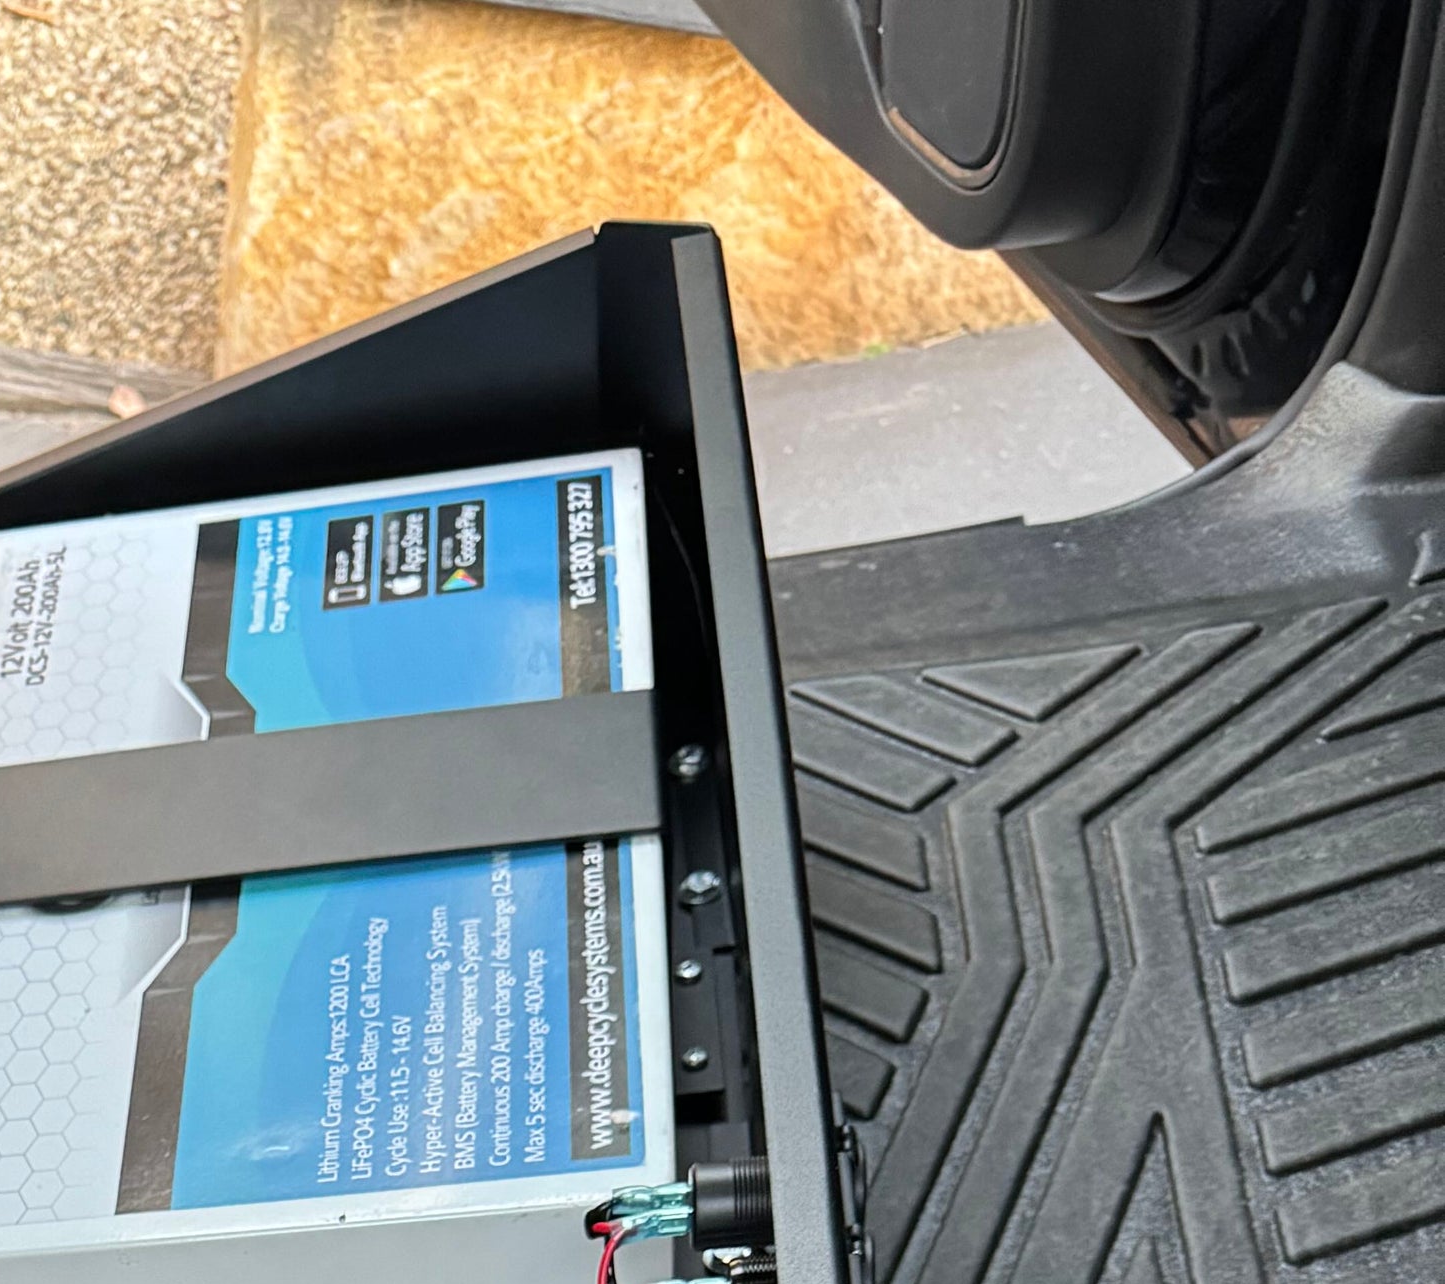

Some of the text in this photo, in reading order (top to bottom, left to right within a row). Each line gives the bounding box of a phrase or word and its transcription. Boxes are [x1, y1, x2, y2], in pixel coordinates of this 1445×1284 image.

[567, 482, 592, 511] 327
[400, 513, 427, 572] App Store
[454, 505, 481, 566] Google Play
[568, 511, 593, 542] 795
[11, 560, 40, 617] 200Ah
[363, 918, 388, 990] Technology
[491, 898, 517, 960] discharge
[331, 955, 350, 982] LCA
[491, 969, 517, 1016] charge
[360, 995, 380, 1018] Cell
[580, 841, 616, 1149] www.deepcyclesystems.com.au
[357, 1021, 382, 1070] Battery
[421, 906, 451, 1173] Hyper-Active Cell Balancing System
[455, 919, 483, 1169] BMS (Battery Management System)
[491, 1019, 515, 1052] Amp
[524, 1017, 550, 1084] discharge
[491, 1055, 510, 1083] 200
[321, 1066, 348, 1126] Cranking
[388, 1104, 408, 1133] Use
[526, 1116, 545, 1125] 5
[530, 1087, 545, 1112] sec
[352, 1117, 373, 1179] LiFePO4
[490, 1086, 512, 1166] Continuous
[524, 1128, 545, 1162] Max
[317, 1130, 339, 1183] Lithium
[386, 1138, 410, 1176] Cycle
